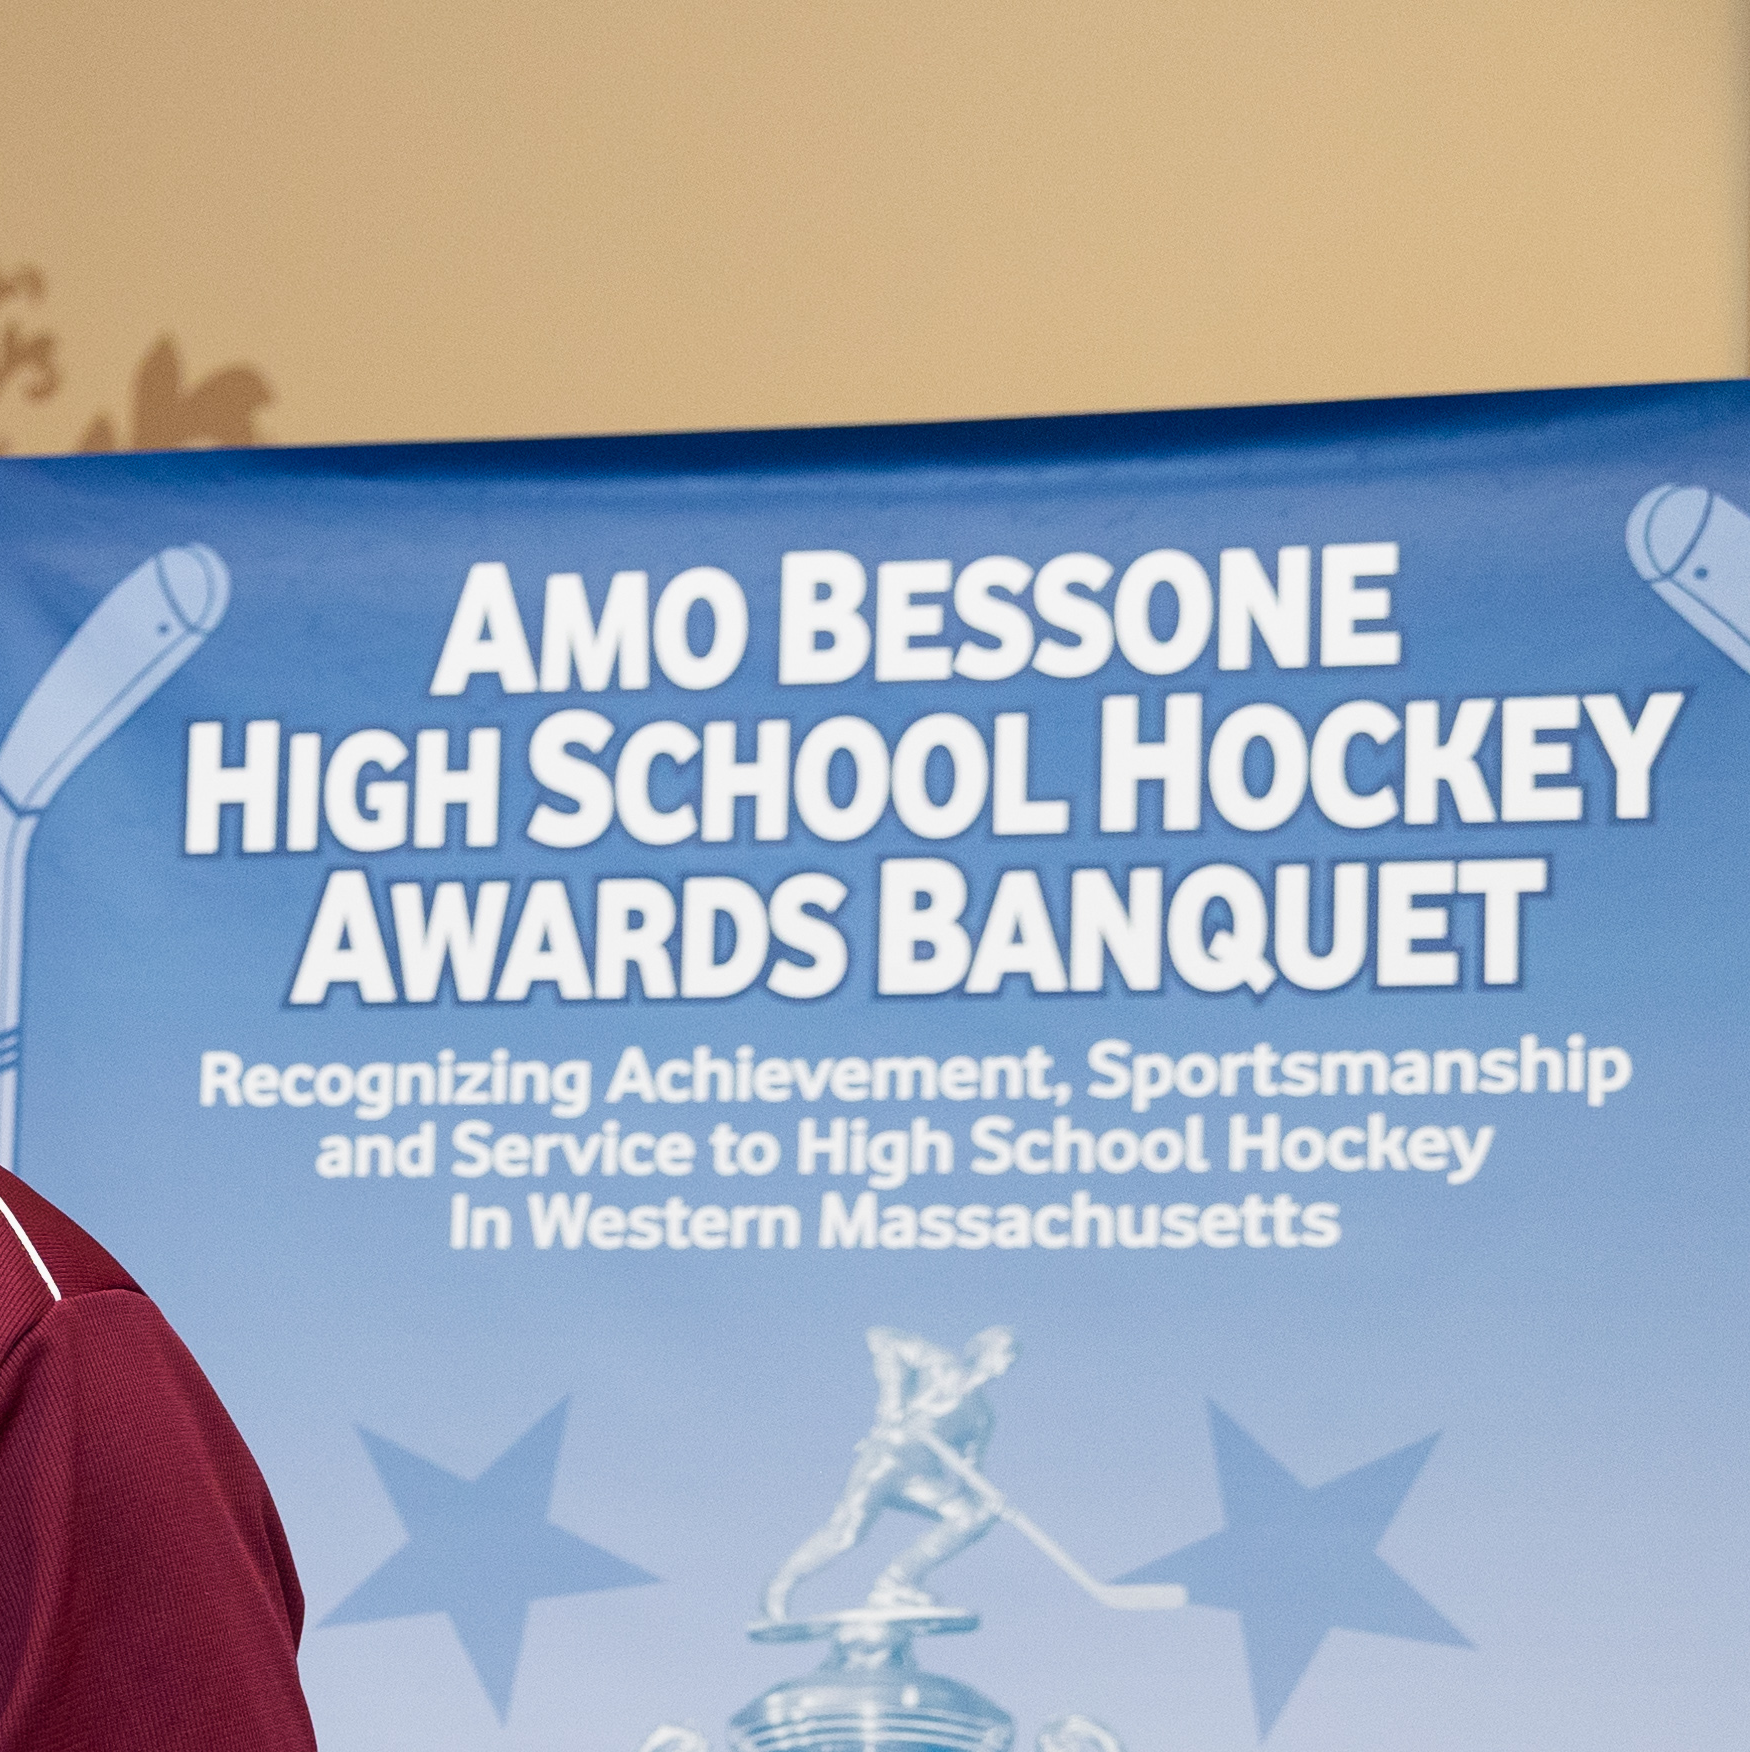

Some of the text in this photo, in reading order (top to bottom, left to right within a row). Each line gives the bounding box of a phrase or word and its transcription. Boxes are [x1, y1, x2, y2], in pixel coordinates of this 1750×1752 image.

[431, 543, 1400, 695] AMO BESSONE
[186, 693, 1683, 854] HIGH SCHOOL HOCKEY
[291, 859, 1546, 1003] AWARDS BANQUET
[200, 1034, 1632, 1122] Recognizing Achievement, Sportsmanship
[316, 1110, 1494, 1189] and Service to High School Hockey
[451, 1191, 1341, 1250] In Western Massachusetts
